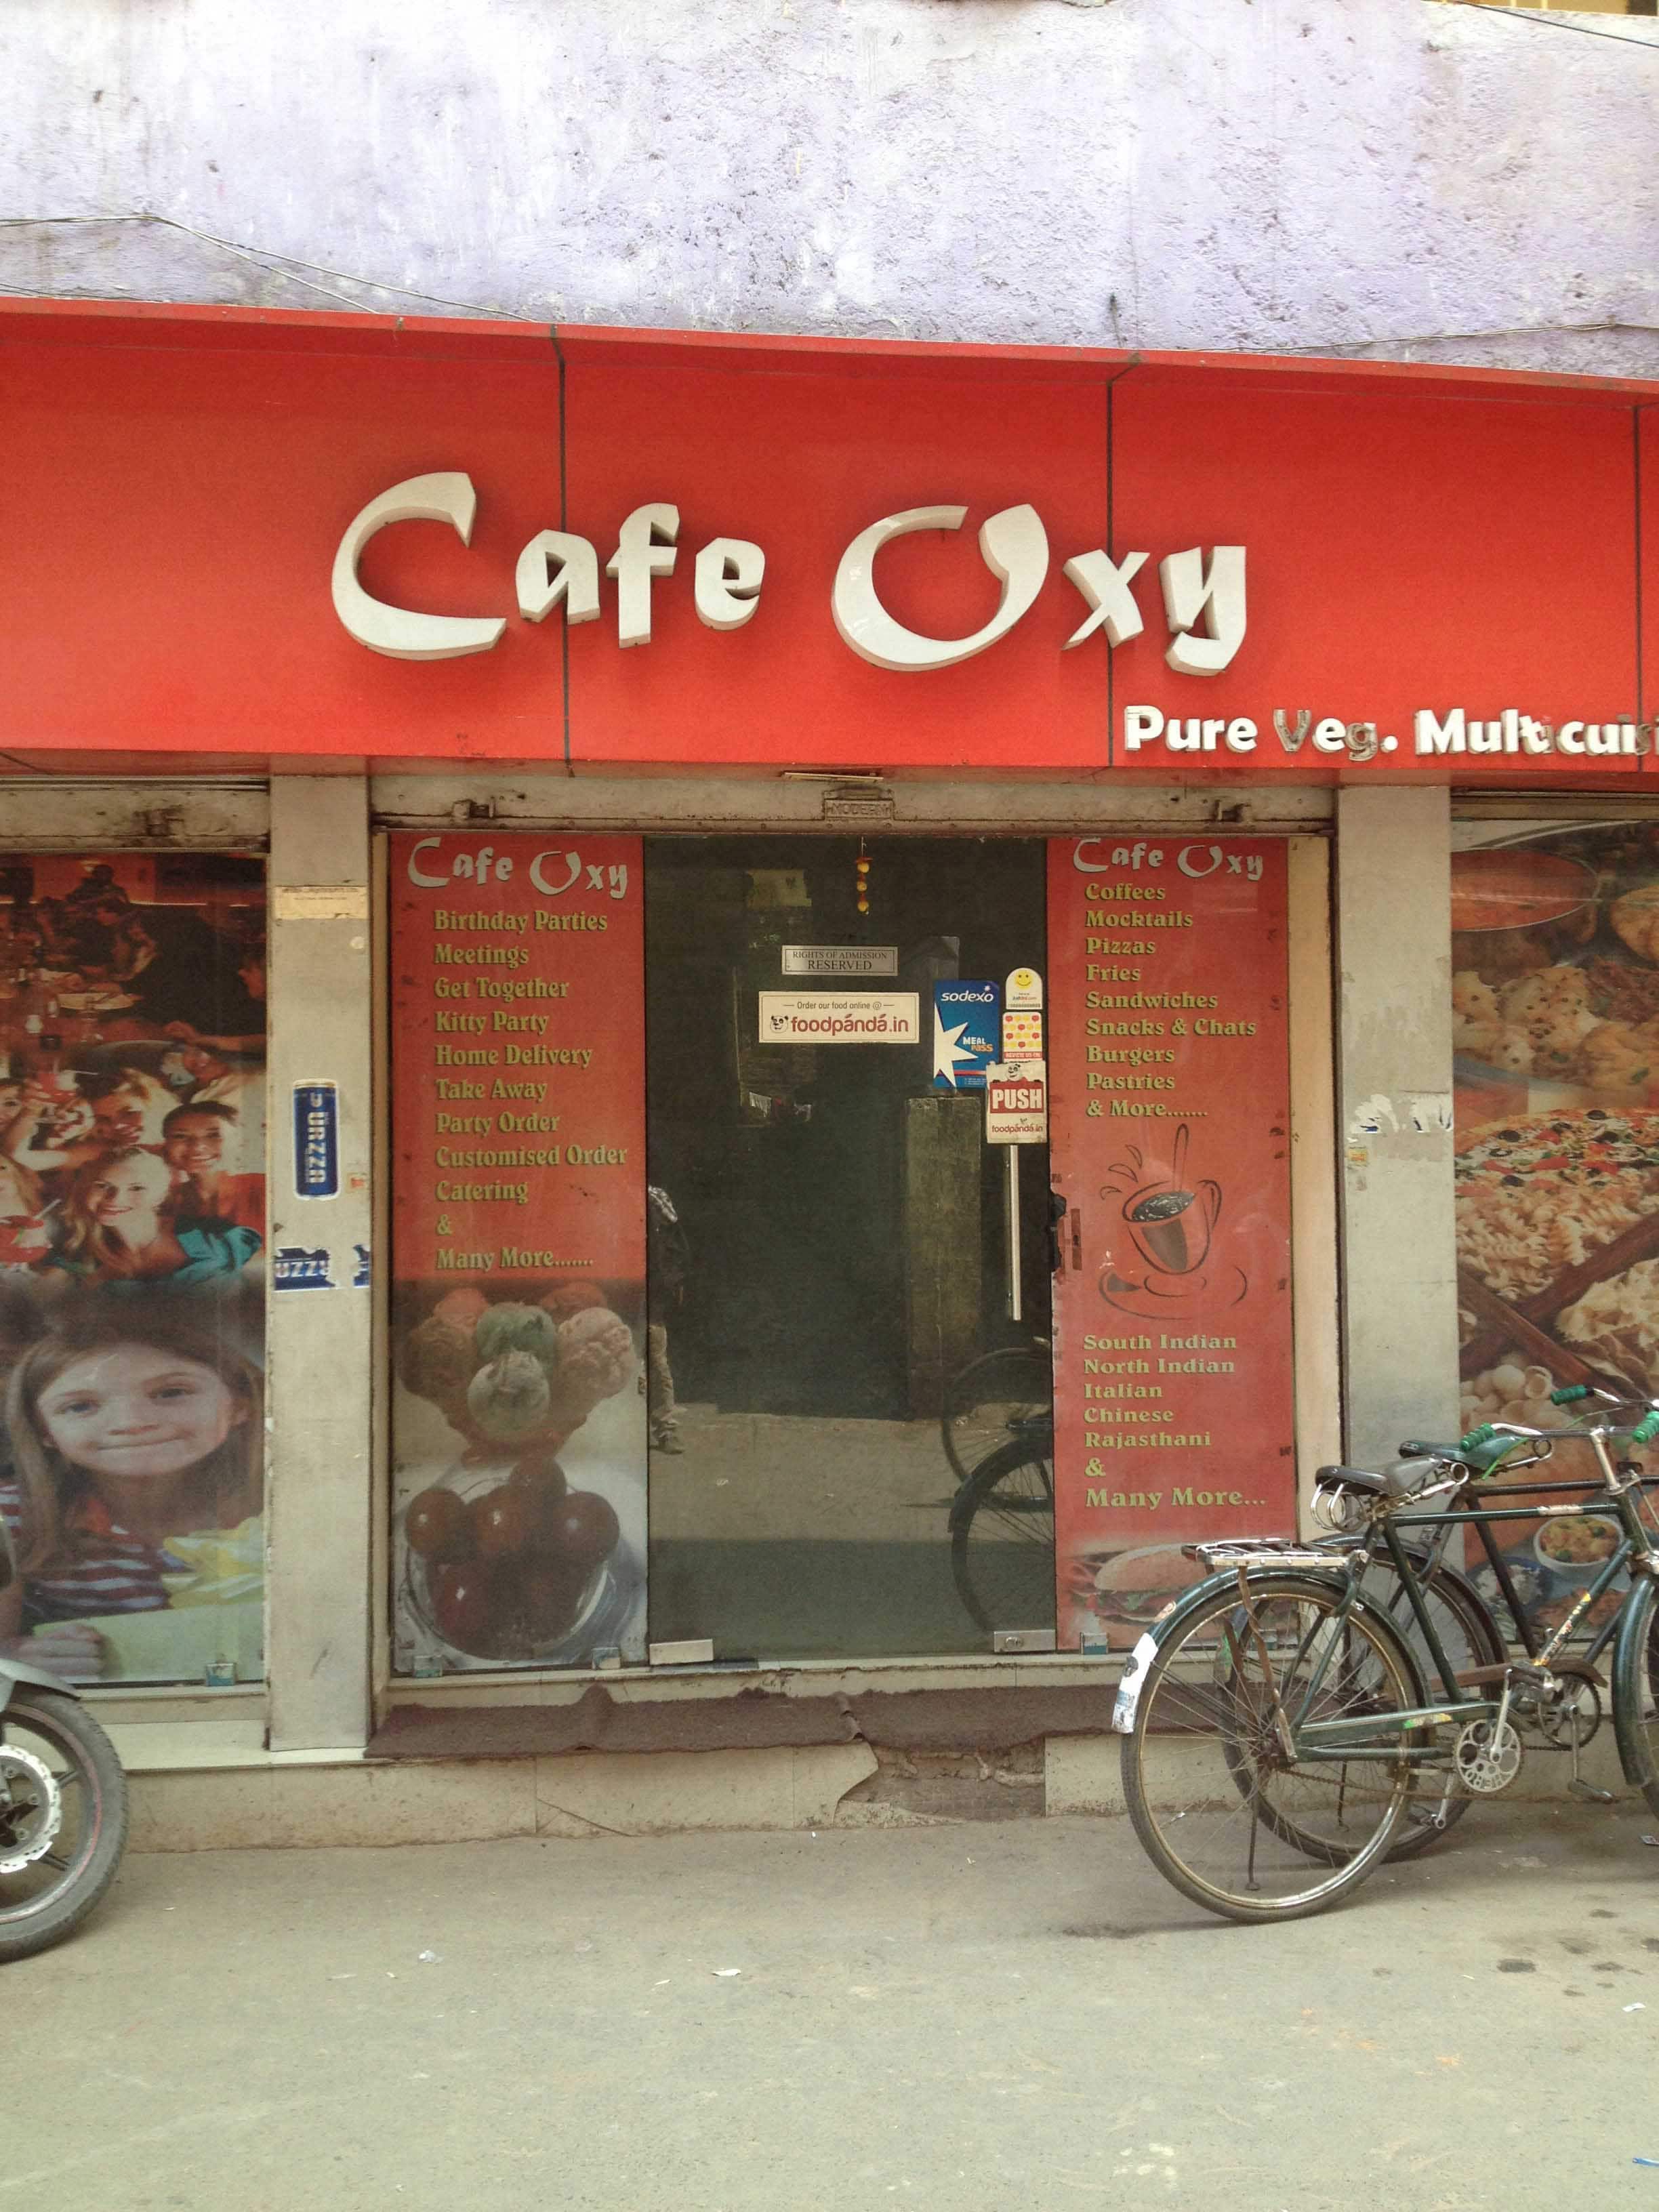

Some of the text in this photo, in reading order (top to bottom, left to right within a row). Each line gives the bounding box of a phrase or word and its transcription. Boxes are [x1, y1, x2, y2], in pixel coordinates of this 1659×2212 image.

[331, 472, 1246, 676] Cafe Oxy
[1124, 705, 1257, 752] Pure
[1273, 709, 1398, 760] Veg.
[408, 837, 628, 899] Cafe Oxy
[1073, 838, 1263, 880] Cafe Oxy
[1085, 884, 1166, 901] Coffees
[434, 910, 608, 935] Birthday Parties
[1085, 910, 1193, 928] Mocktails
[434, 944, 529, 968] Meetings
[840, 951, 888, 960] ADMISSION
[1085, 938, 1156, 955] Pizzas
[808, 960, 872, 970] RESERVED
[1086, 965, 1141, 982] Fries
[434, 978, 569, 1002] Get Together
[941, 990, 994, 1002] sodexo
[1086, 991, 1218, 1009] Sandwiches
[435, 1011, 550, 1035] Kitty Party
[1086, 1019, 1256, 1036] Snacks & Chats
[963, 1037, 986, 1045] MEAL
[435, 1044, 592, 1068] Home Delivery
[1087, 1046, 1175, 1067] Burgers
[435, 1078, 548, 1103] Take Away
[1087, 1073, 1175, 1090] Pastries
[992, 1088, 1042, 1109] PUSH
[1087, 1100, 1102, 1117] &
[436, 1111, 560, 1136] Party Order
[435, 1144, 628, 1167] Customised Order
[435, 1181, 528, 1204] Catering
[436, 1214, 452, 1235] &
[436, 1248, 495, 1271] Many
[1084, 1334, 1237, 1351] South Indian
[1084, 1358, 1235, 1374] North Indian
[1084, 1383, 1163, 1399] Italian
[1084, 1408, 1174, 1424] Chinese
[1085, 1432, 1211, 1450] Rajasthani
[1085, 1458, 1107, 1477] &
[1086, 1488, 1267, 1510] Many More...
